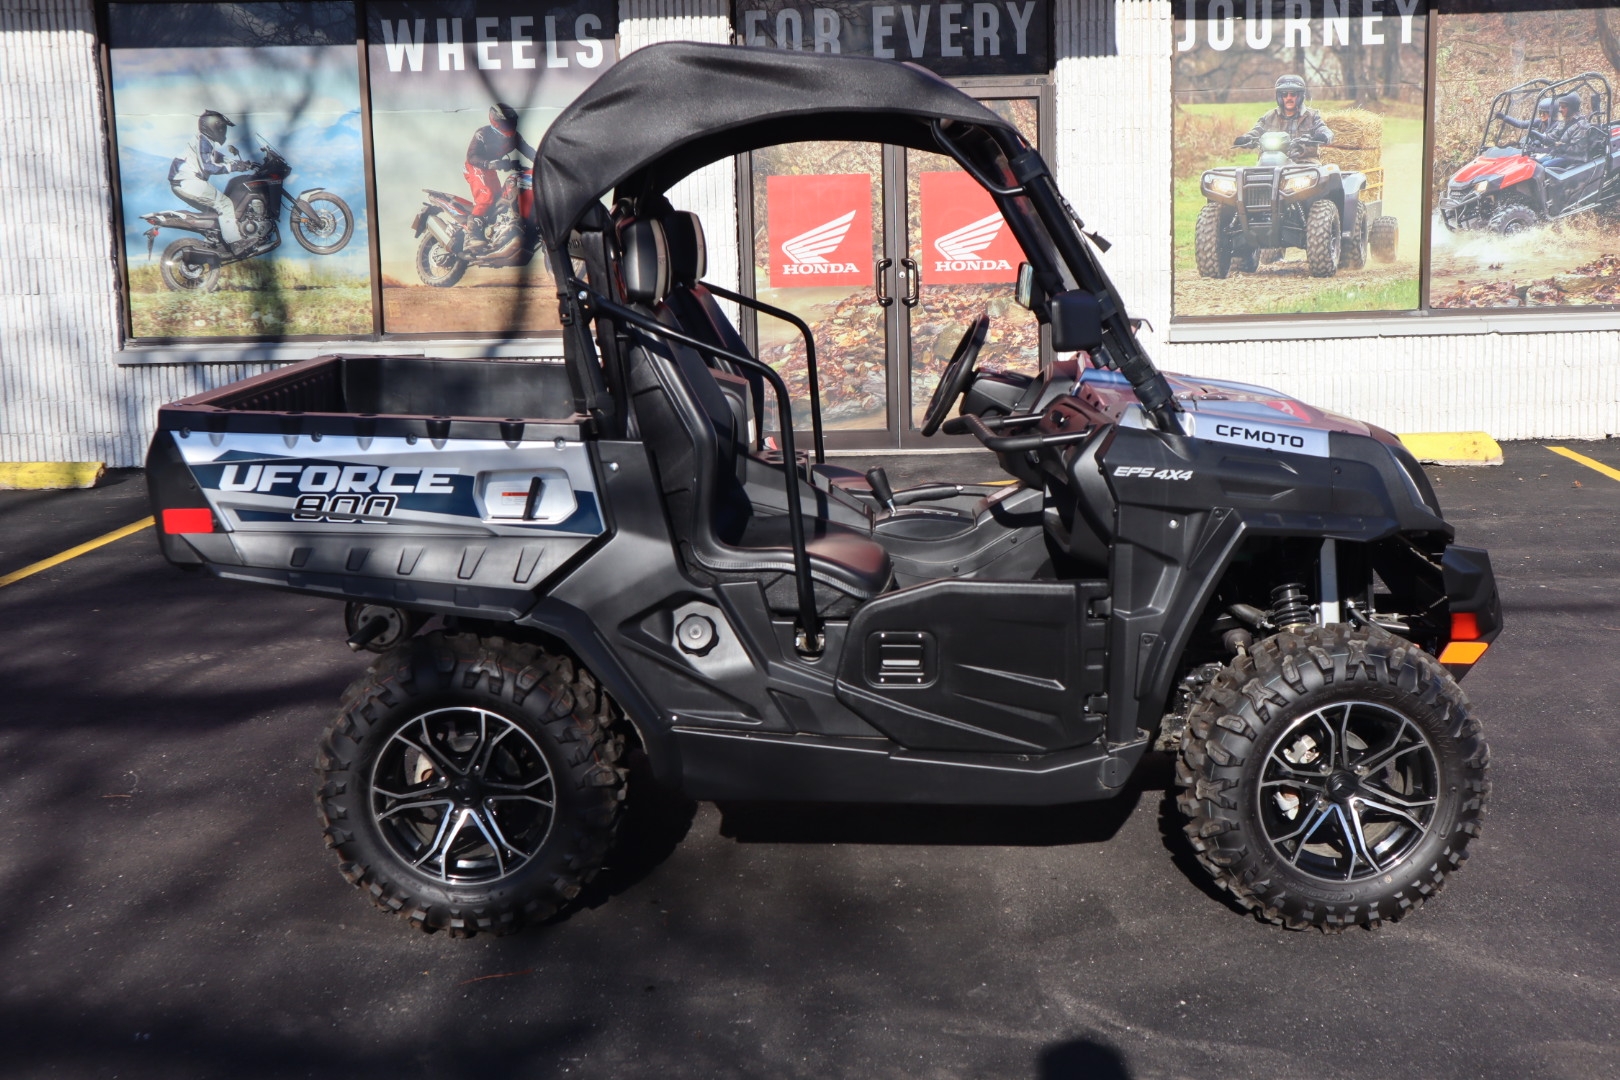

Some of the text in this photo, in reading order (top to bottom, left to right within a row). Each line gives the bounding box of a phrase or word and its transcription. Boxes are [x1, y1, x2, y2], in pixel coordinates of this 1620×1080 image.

[745, 1, 1036, 59] FOR EVERY
[1177, 0, 1420, 51] JOURNEY
[381, 13, 603, 72] WHEELS
[782, 262, 860, 275] HONDA
[934, 259, 1013, 272] HONDA
[1216, 424, 1304, 448] CFMOTO
[218, 464, 460, 494] UFORCE
[1113, 466, 1193, 481] EPS 4X4
[291, 493, 398, 524] 800
